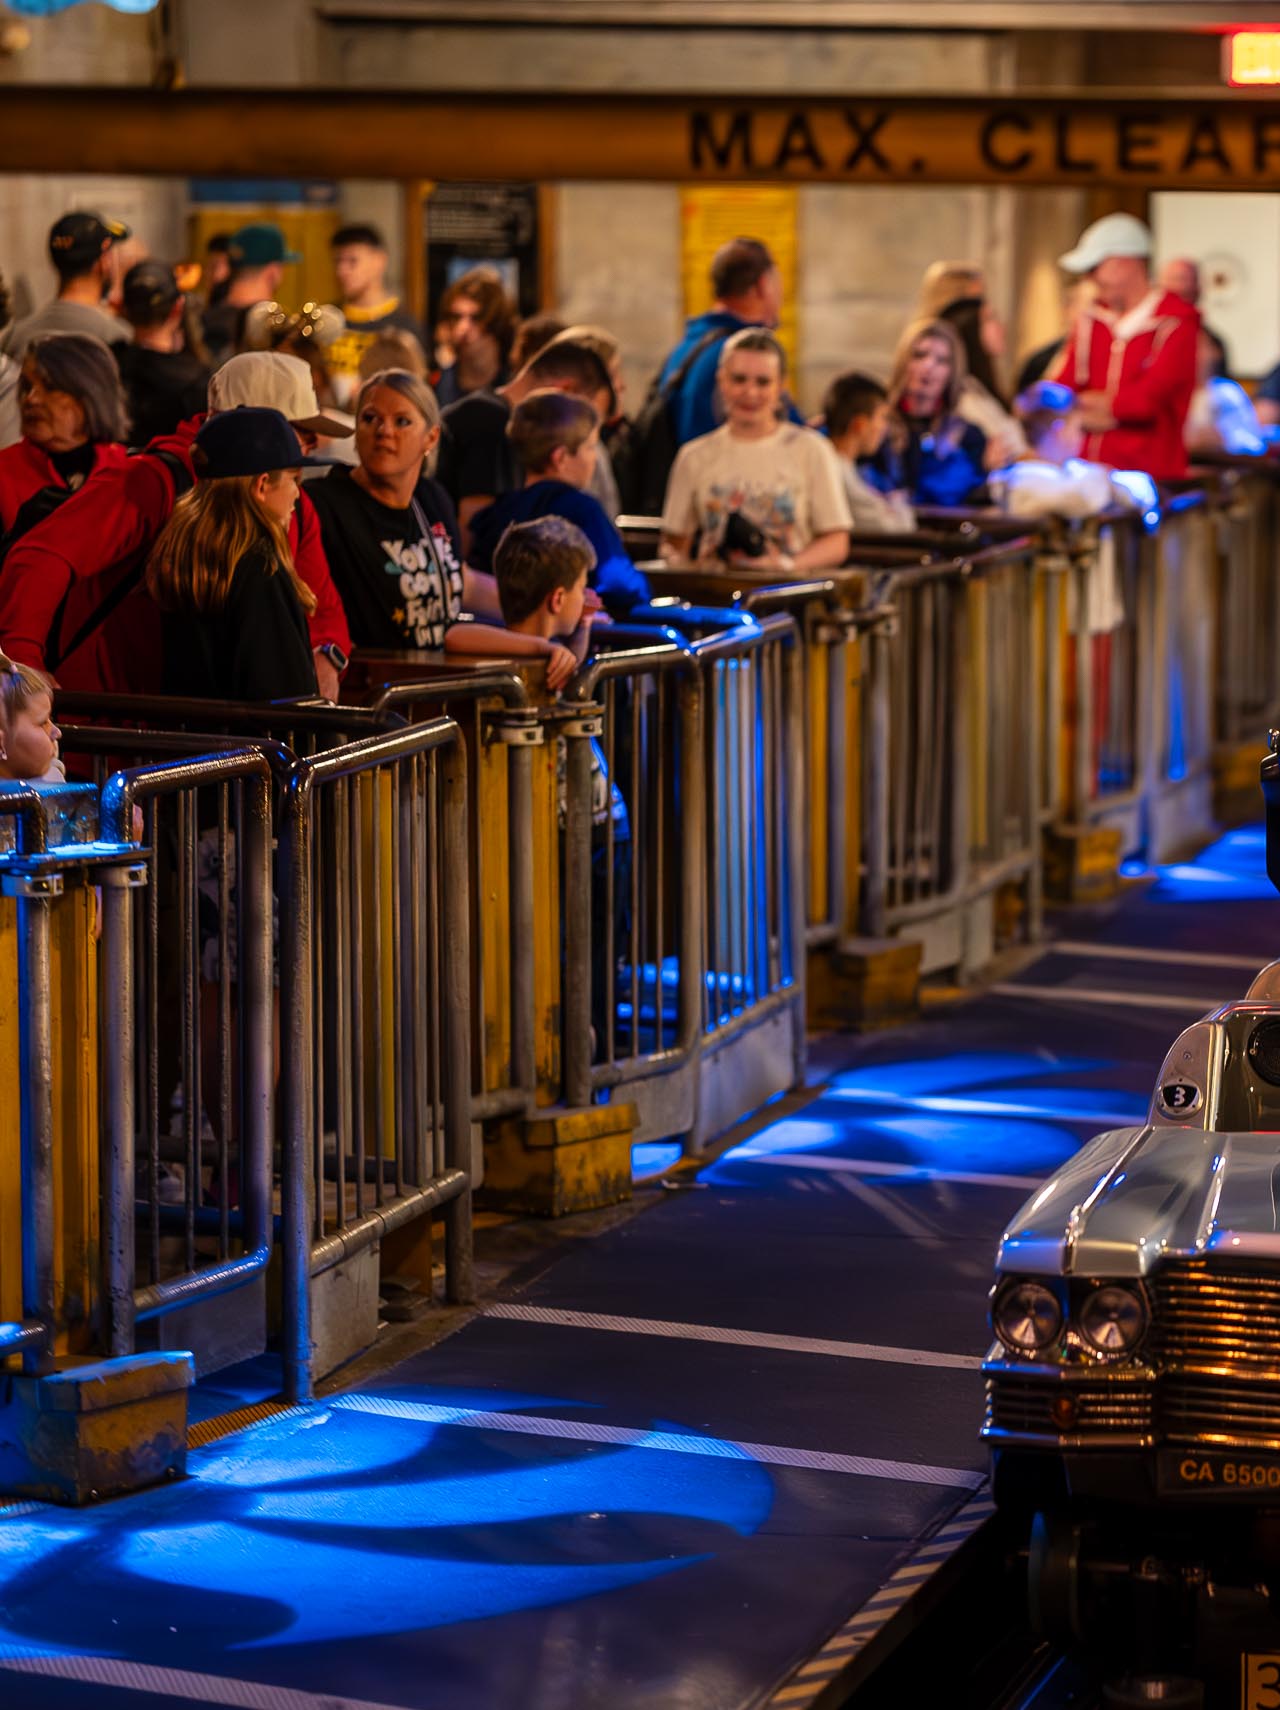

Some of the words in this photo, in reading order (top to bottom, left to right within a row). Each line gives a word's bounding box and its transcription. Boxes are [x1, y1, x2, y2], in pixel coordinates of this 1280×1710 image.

[690, 110, 926, 172] MAX.
[1173, 1086, 1186, 1106] 3
[1180, 1459, 1214, 1482] CA
